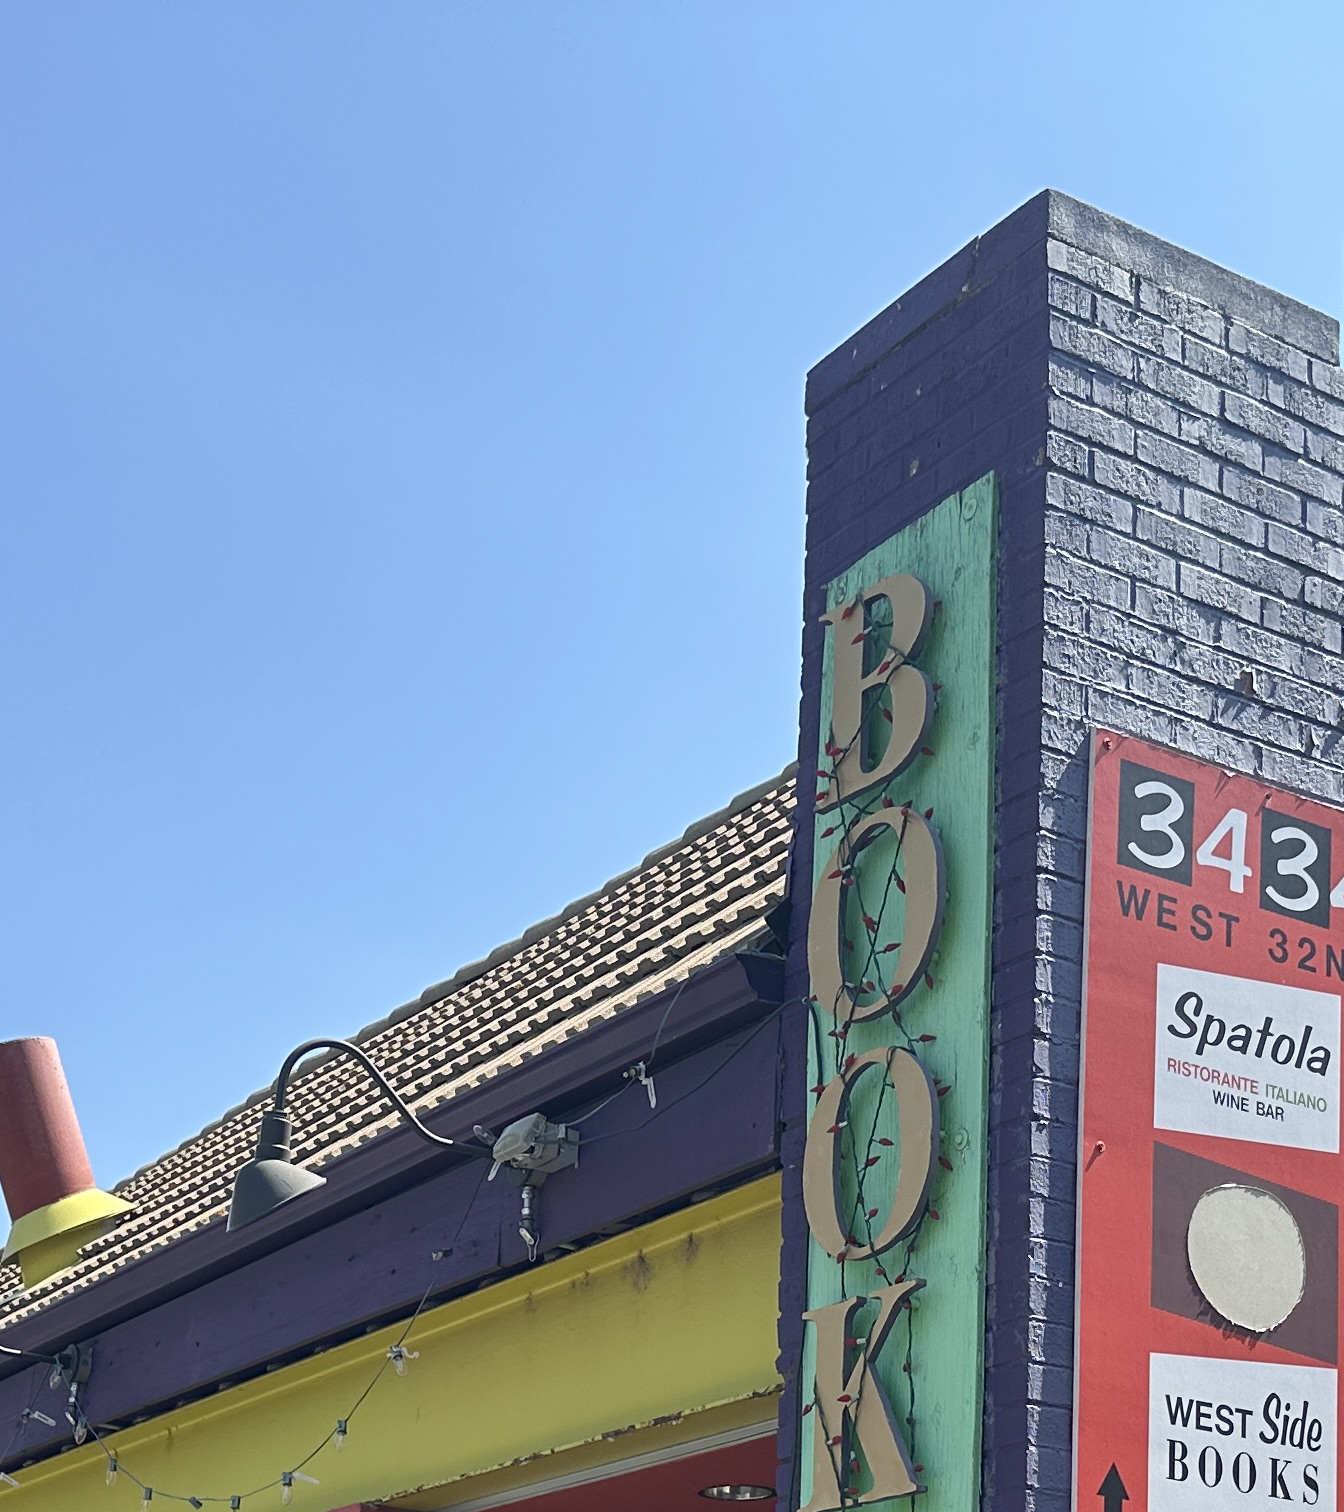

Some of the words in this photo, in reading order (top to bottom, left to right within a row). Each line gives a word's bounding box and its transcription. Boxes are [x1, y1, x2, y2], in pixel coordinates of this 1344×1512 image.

[1116, 880, 1240, 948] WEST
[1167, 991, 1332, 1077] Spatola
[1167, 1057, 1260, 1096] RISTORANTE
[1264, 1083, 1328, 1113] ITALIANO
[1212, 1090, 1250, 1113] WINE
[1256, 1097, 1285, 1122] BAR
[1164, 1393, 1254, 1439] WEST
[1258, 1392, 1323, 1452] Side
[1165, 1438, 1320, 1506] BOOKS
